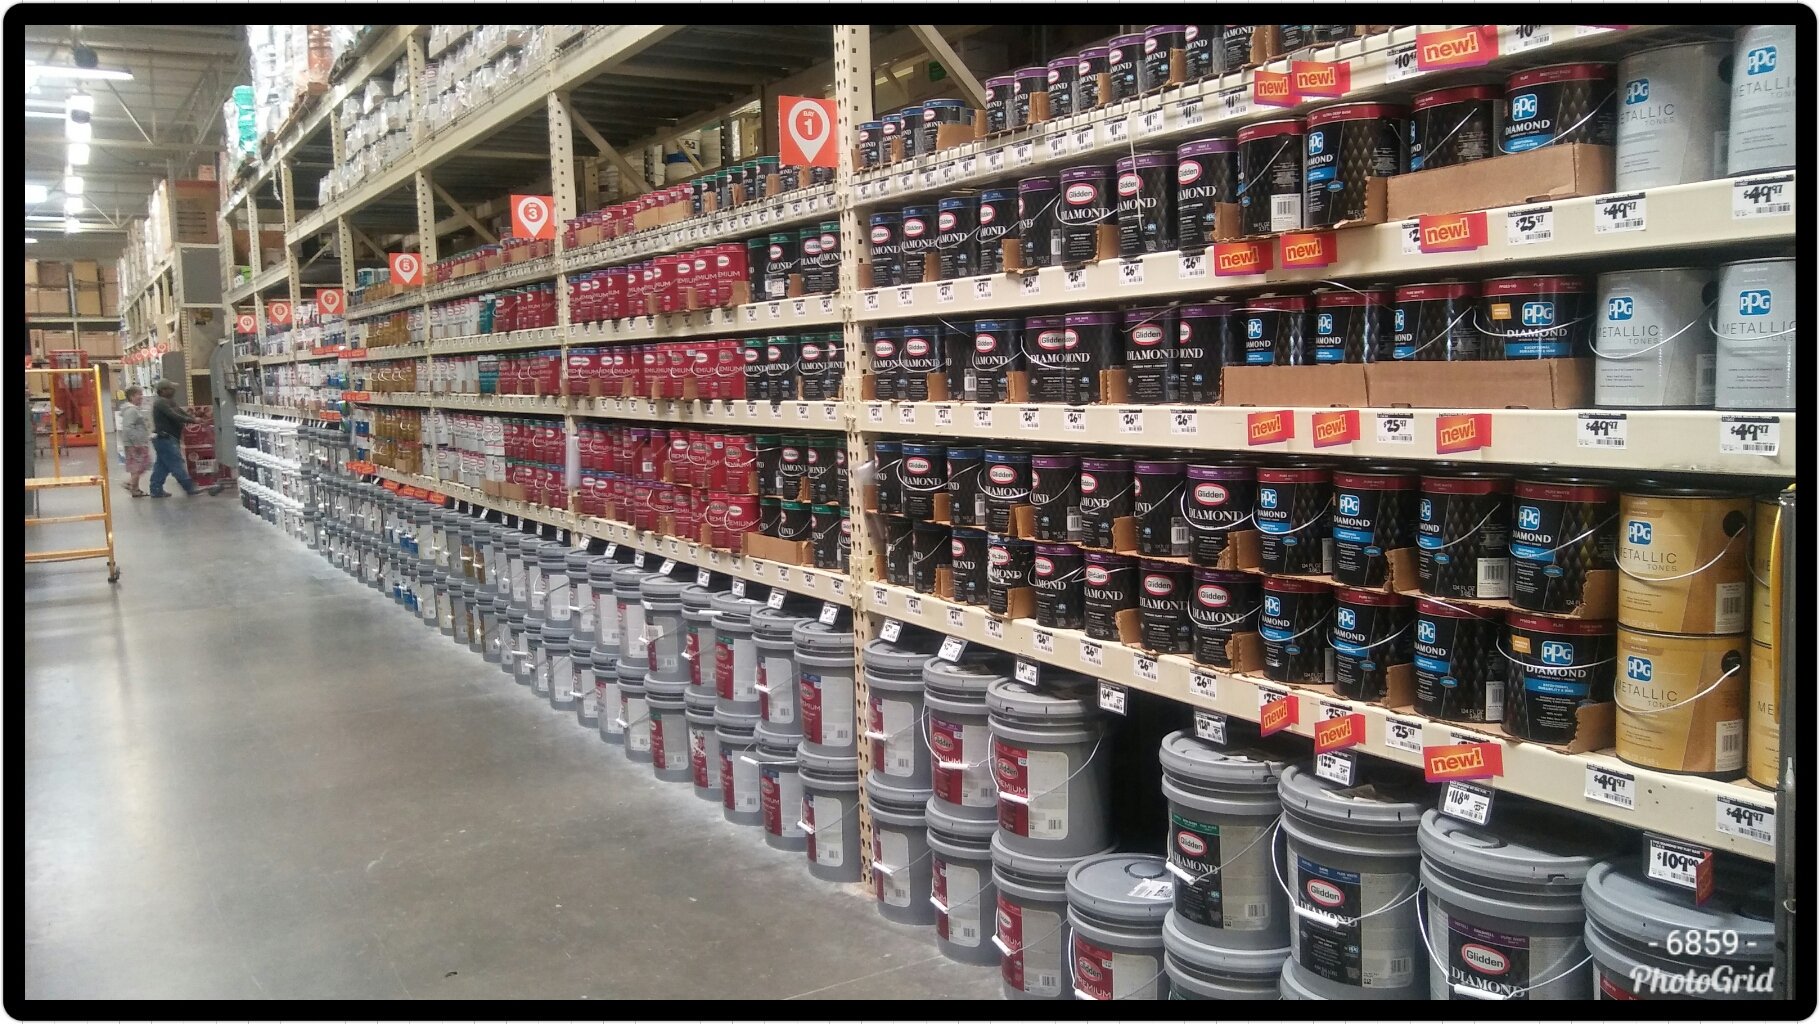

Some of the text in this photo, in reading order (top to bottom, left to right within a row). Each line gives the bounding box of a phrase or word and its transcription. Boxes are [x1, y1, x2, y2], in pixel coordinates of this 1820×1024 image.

[1424, 31, 1479, 62] new!
[1748, 49, 1777, 72] PPG
[1258, 78, 1289, 96] new!
[1297, 69, 1335, 88] new!
[1627, 81, 1649, 101] PPG
[1513, 97, 1537, 118] PPG
[1620, 104, 1675, 124] ETALLIC
[804, 118, 813, 136] 1
[1505, 119, 1551, 136] DIAMOND
[1068, 190, 1093, 199] Glidden
[528, 207, 537, 220] 3
[1425, 219, 1470, 244] new!
[1286, 238, 1322, 259] new!
[402, 261, 410, 272] 5
[1219, 250, 1259, 270] new!
[1609, 299, 1632, 319] PPG
[1740, 292, 1770, 314] PPG
[1524, 305, 1553, 323] PPG
[1135, 329, 1161, 339] Glidden
[1506, 328, 1568, 338] DIAMOND
[1251, 414, 1282, 438] new!
[1317, 416, 1347, 441] new!
[1441, 418, 1475, 445] new!
[1197, 490, 1225, 499] Glidden
[1189, 507, 1244, 522] DIAMOND
[1340, 495, 1359, 516] PPG
[1519, 507, 1539, 530] PPG
[1629, 522, 1651, 543] PPG
[1200, 591, 1227, 602] Glidden
[1338, 609, 1355, 629] PPG
[1418, 620, 1435, 642] PPG
[1544, 643, 1572, 662] PPG
[1526, 665, 1587, 678] DIAMOND
[1628, 657, 1651, 679] PPG
[1264, 702, 1288, 728] new!
[1319, 720, 1352, 746] new!
[1431, 747, 1484, 773] new!
[1180, 836, 1203, 851] Glidden
[1310, 885, 1340, 901] Glidden
[1466, 950, 1504, 968] Glidden
[1451, 966, 1526, 998] DIAMOND
